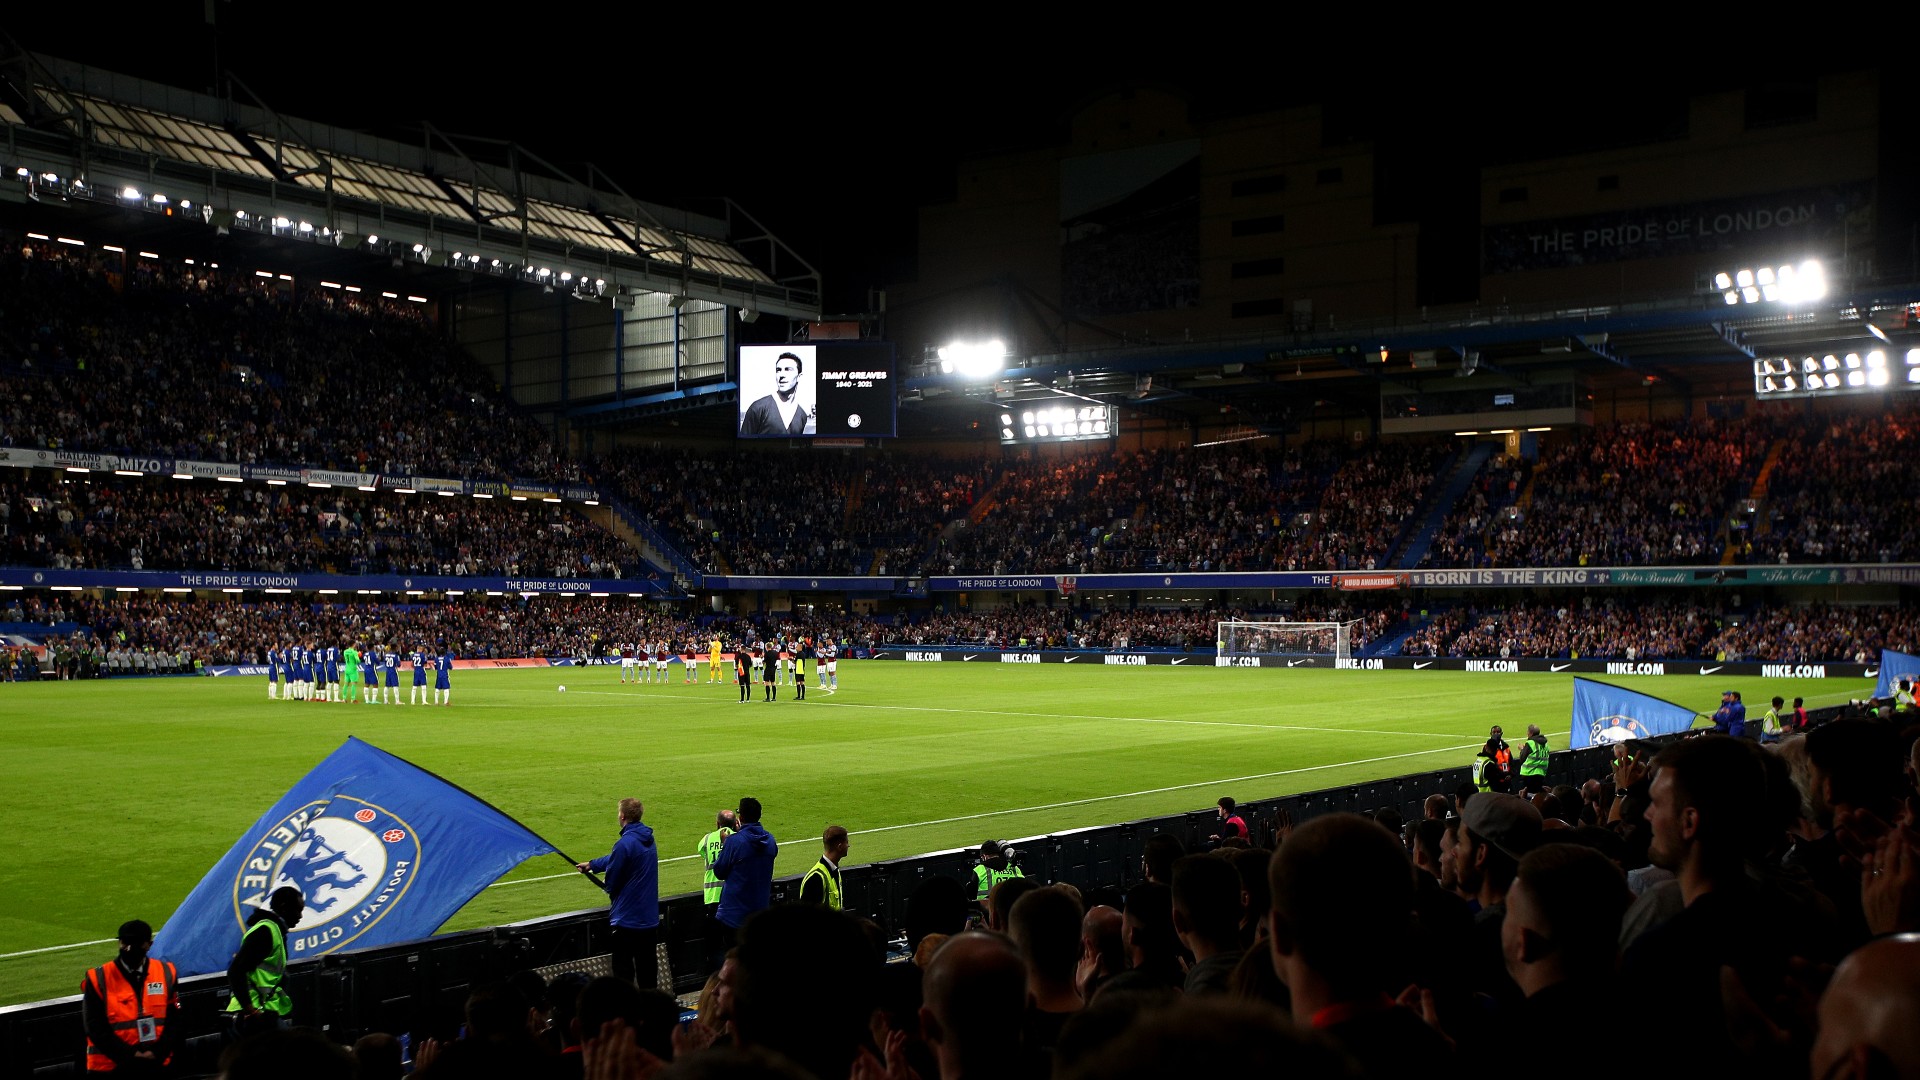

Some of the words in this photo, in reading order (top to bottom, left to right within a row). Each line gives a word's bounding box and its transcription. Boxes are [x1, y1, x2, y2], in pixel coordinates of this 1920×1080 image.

[1529, 232, 1575, 254] THE
[1583, 222, 1658, 249] PRIDE
[1666, 218, 1691, 235] OF
[1698, 202, 1816, 236] LONDON
[822, 371, 848, 380] JIMMY
[849, 371, 887, 380] GREAVES
[54, 452, 101, 462] THAILAND
[72, 460, 101, 470] BLUES
[121, 458, 161, 473] MIZO
[191, 464, 213, 475] Kerry
[216, 466, 239, 476] Blues
[251, 466, 300, 477] easternblues
[341, 474, 358, 483] BLUES
[382, 476, 410, 486] FRANCE
[474, 481, 500, 490] ATLANTA
[181, 575, 202, 585] THE
[205, 575, 238, 586] PRIDE
[253, 576, 298, 587] LONDON
[1312, 575, 1330, 584] THE
[1361, 577, 1394, 586] AWAKENING
[1424, 572, 1471, 585] BORN
[1477, 571, 1493, 585] IS
[1502, 571, 1535, 584] THE
[1542, 569, 1587, 584] KING
[1617, 571, 1643, 583] Peter
[505, 581, 521, 590] THE
[523, 581, 547, 590] PRIDE
[558, 582, 591, 590] LONDON
[957, 580, 972, 588] THE
[973, 579, 997, 588] PRIDE
[1008, 579, 1042, 587] LONDON
[327, 650, 334, 661] 14
[363, 655, 371, 665] 24
[905, 652, 942, 662] NIKE.COM
[1001, 653, 1041, 663] NIKE.COM
[1104, 655, 1147, 666] NIKE.COM
[385, 658, 394, 668] 20
[412, 656, 421, 667] 22
[438, 660, 444, 670] 7
[1465, 660, 1519, 672] NIKE.COM
[1606, 662, 1665, 675] NIKE.COM
[1761, 664, 1826, 678] NIKE.COM
